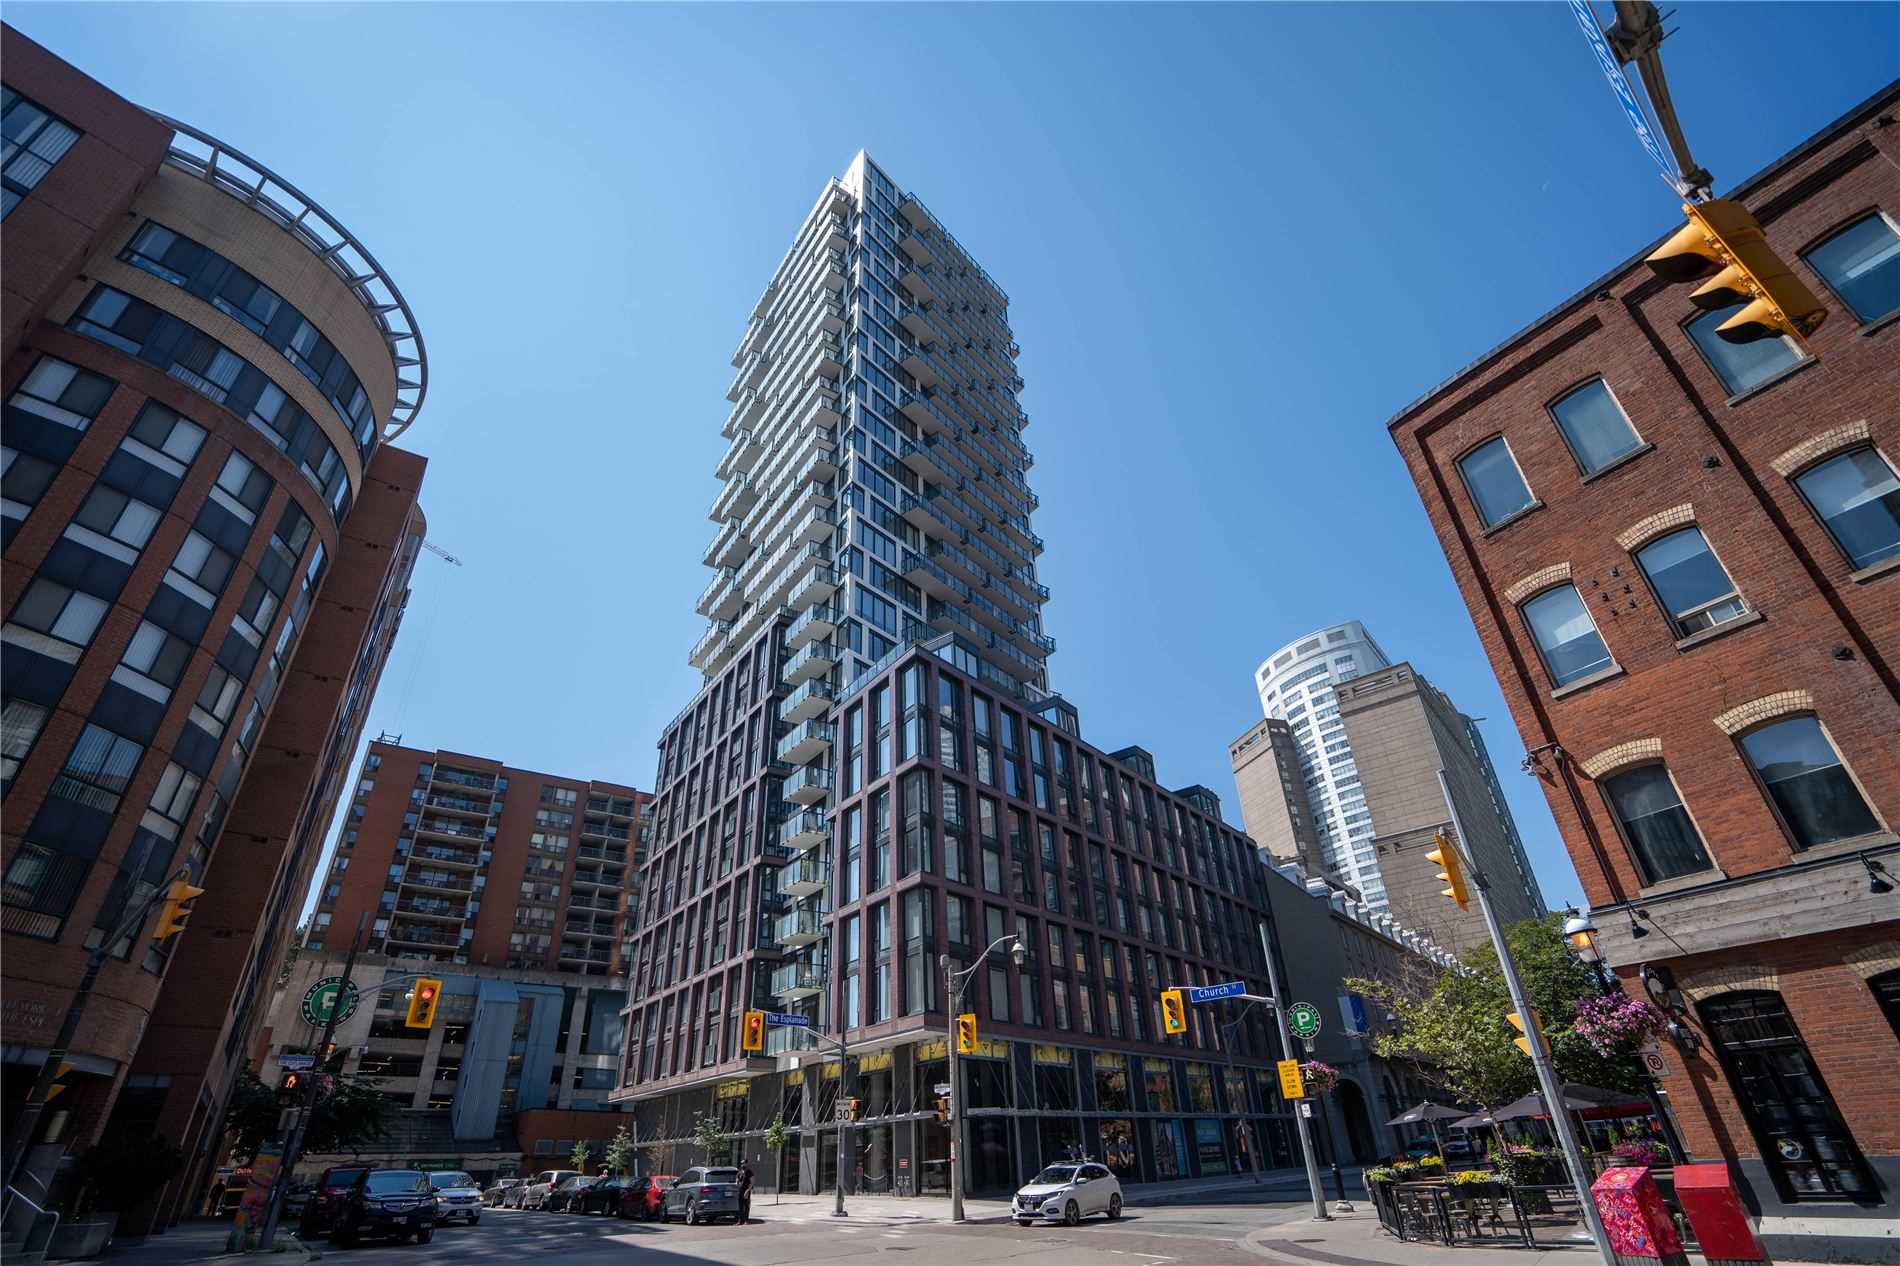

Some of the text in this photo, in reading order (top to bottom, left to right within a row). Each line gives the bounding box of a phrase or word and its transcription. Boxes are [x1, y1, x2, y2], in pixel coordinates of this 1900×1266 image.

[1198, 985, 1229, 998] Church
[769, 1014, 808, 1025] The Esplanade
[1296, 1011, 1310, 1026] P
[837, 1109, 850, 1120] 30
